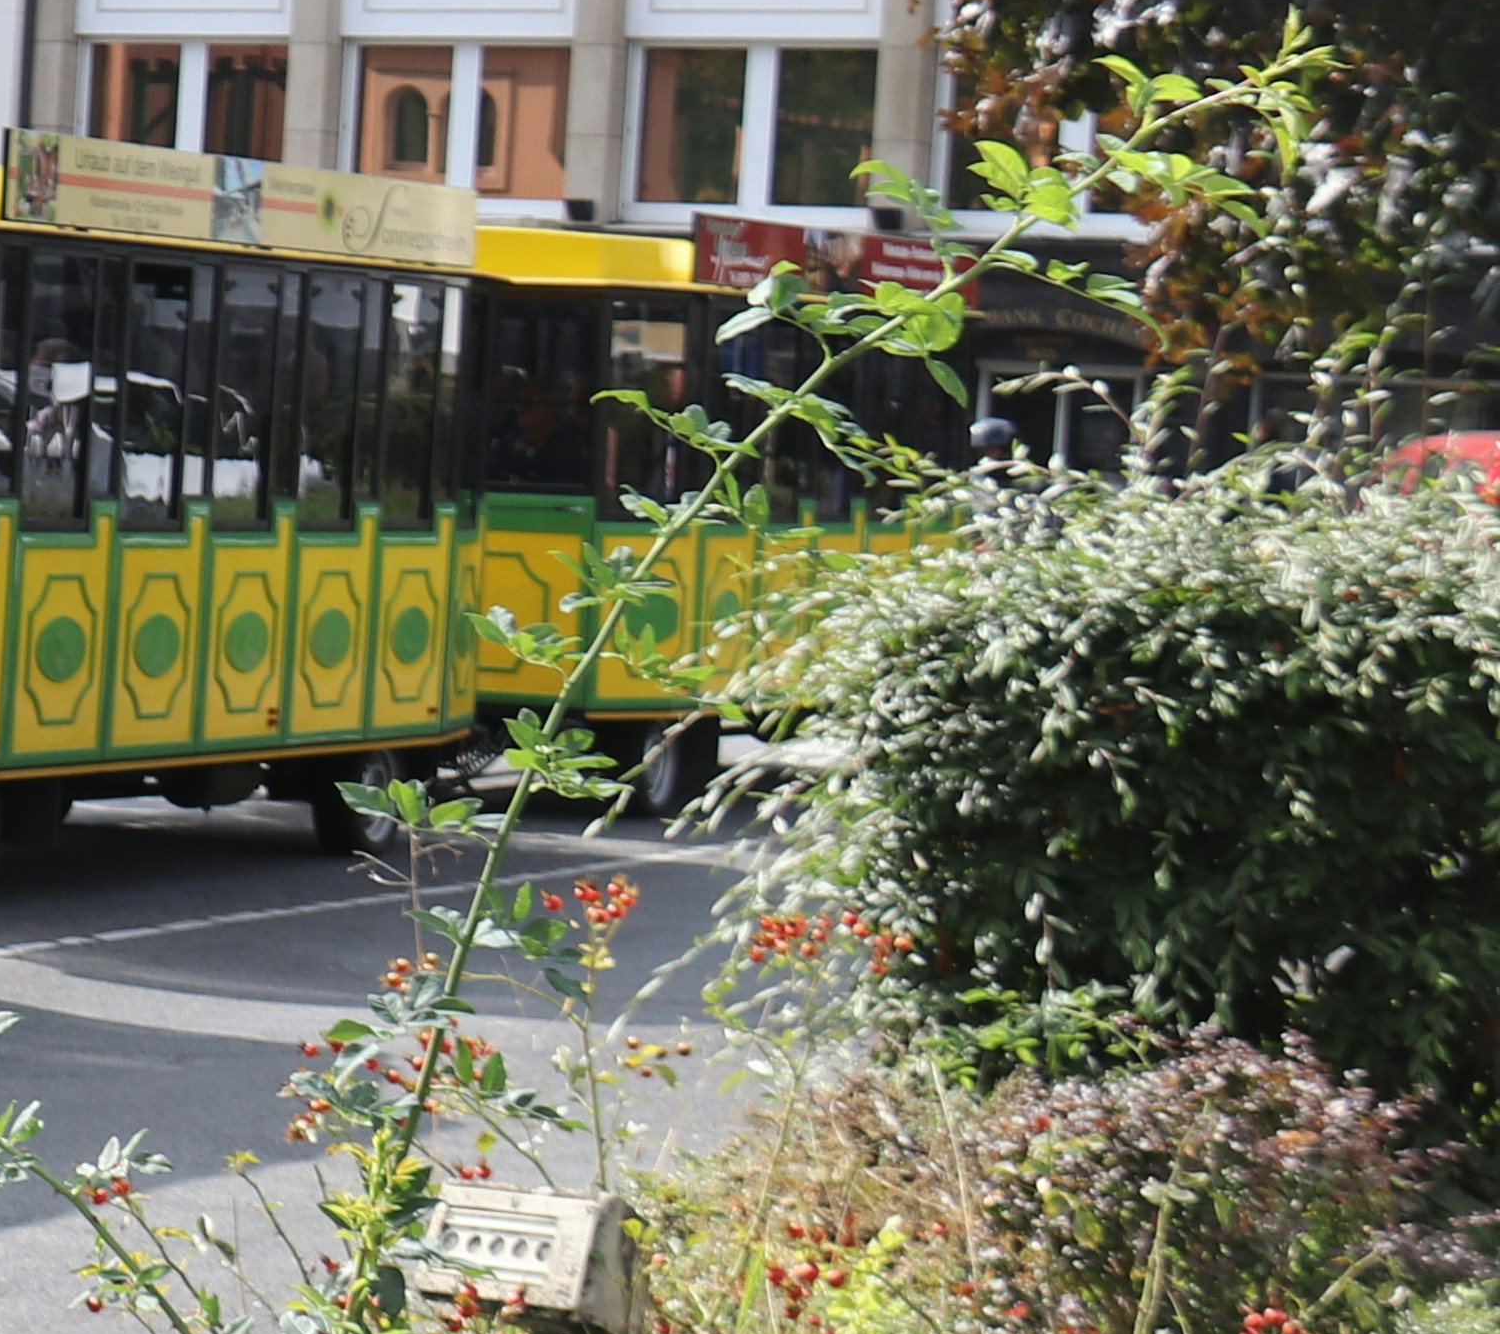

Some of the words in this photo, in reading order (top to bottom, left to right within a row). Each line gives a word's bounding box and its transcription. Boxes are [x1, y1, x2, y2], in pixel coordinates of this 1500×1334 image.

[74, 147, 111, 172] Urlaub
[113, 152, 130, 174] auf
[159, 157, 202, 186] Weingut
